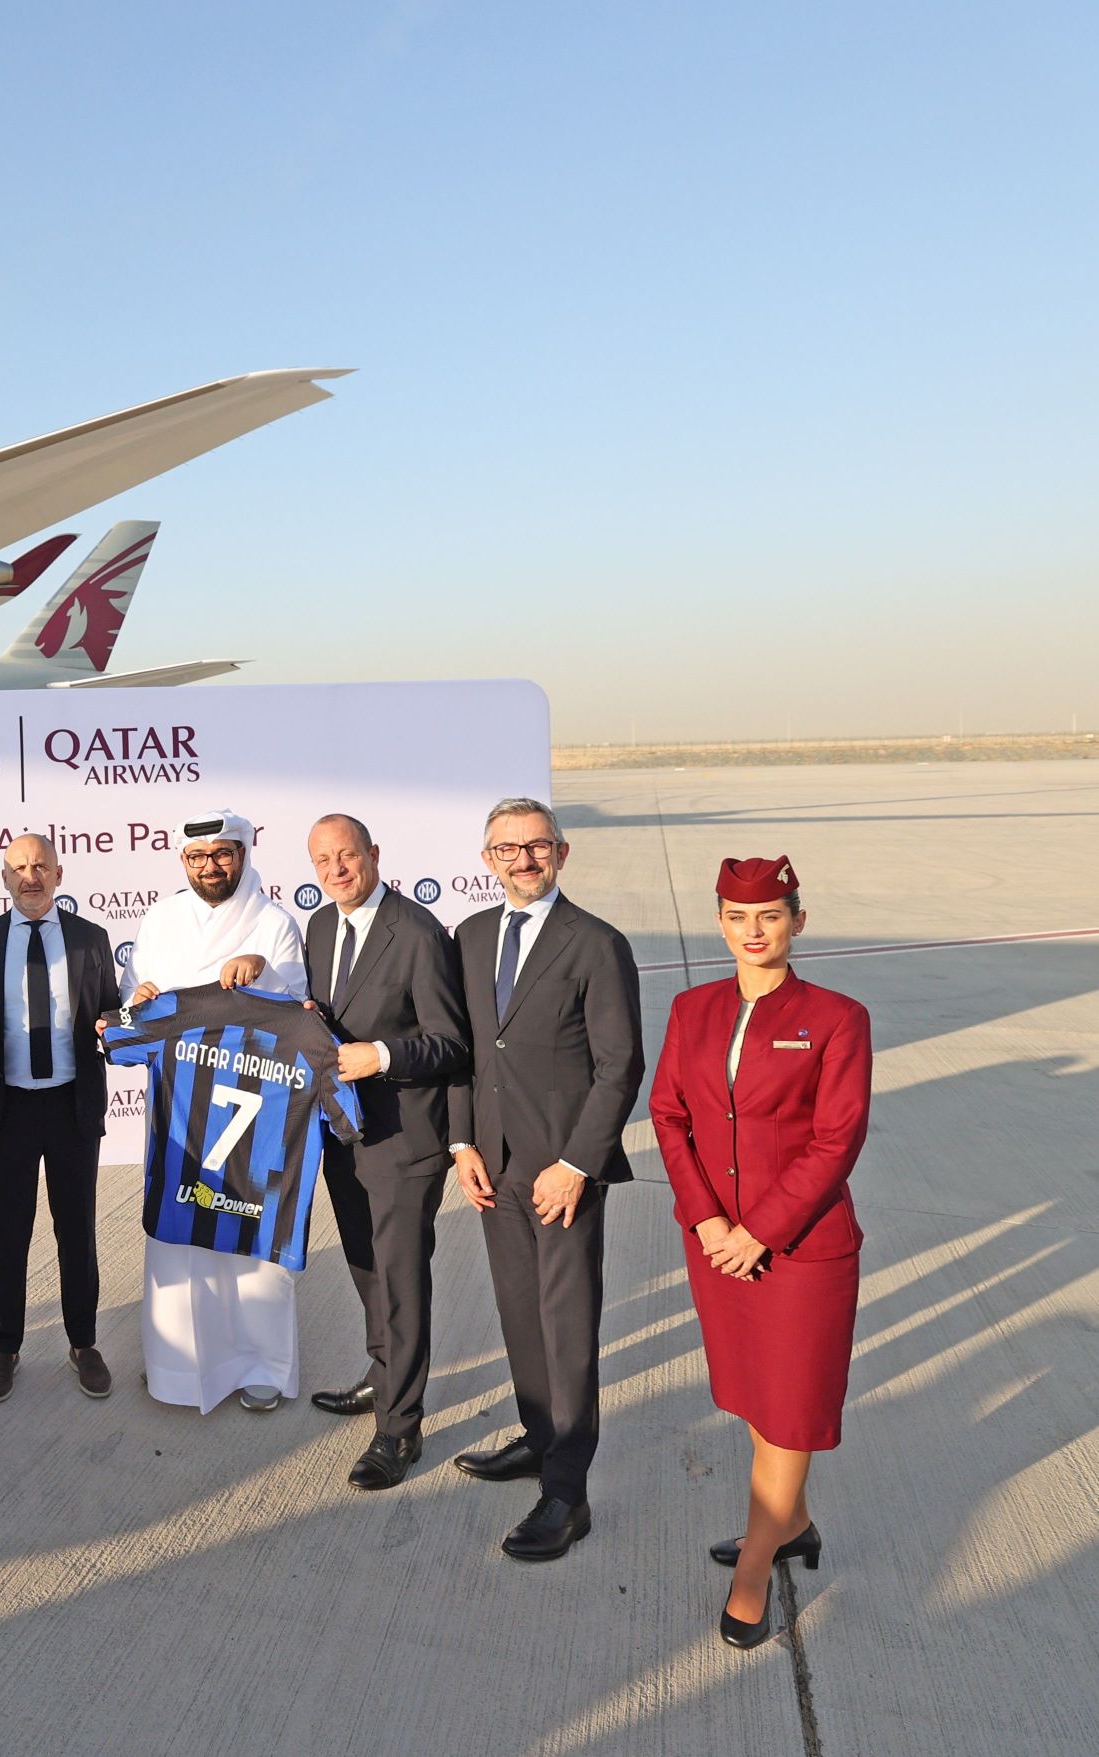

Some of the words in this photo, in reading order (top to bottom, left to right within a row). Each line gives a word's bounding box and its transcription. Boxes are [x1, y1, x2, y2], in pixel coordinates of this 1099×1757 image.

[43, 725, 199, 770] QATAR
[83, 762, 201, 786] AIRWAYS
[451, 874, 506, 895] QATA
[88, 890, 159, 912] QATAR
[468, 891, 507, 903] AIRWA
[105, 908, 149, 920] AIRWA
[174, 1040, 231, 1070] QATAR
[232, 1052, 306, 1090] AIRWAYS
[109, 1088, 146, 1107] ATA
[108, 1106, 146, 1118] AIRW
[201, 1083, 264, 1172] 7
